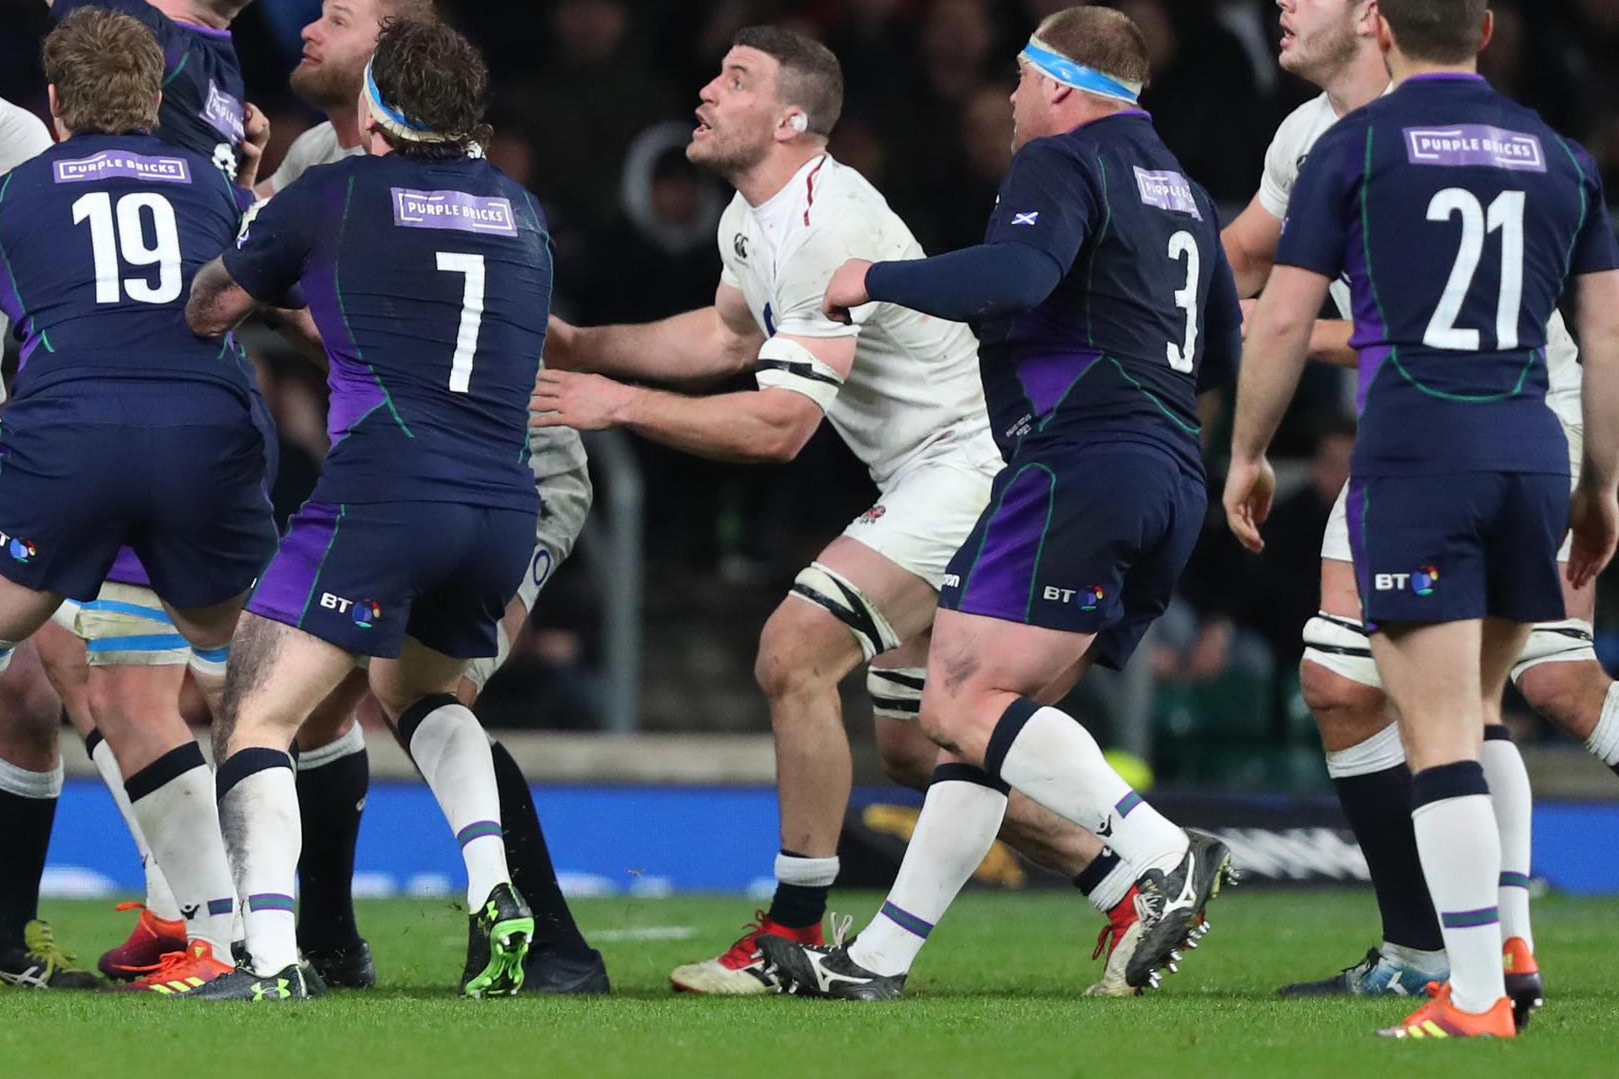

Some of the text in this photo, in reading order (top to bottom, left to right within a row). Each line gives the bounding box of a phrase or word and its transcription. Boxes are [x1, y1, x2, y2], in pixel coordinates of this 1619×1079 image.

[1421, 137, 1480, 152] PURPLE
[68, 158, 176, 174] PURPLE BRICKS
[407, 201, 504, 223] PURPLE BRICKS
[71, 191, 183, 304] 19
[1422, 186, 1526, 351] 21
[1166, 230, 1200, 374] 3
[435, 251, 486, 393] 7
[1375, 573, 1411, 591] BT
[320, 592, 354, 614] BT
[1042, 585, 1077, 604] BT
